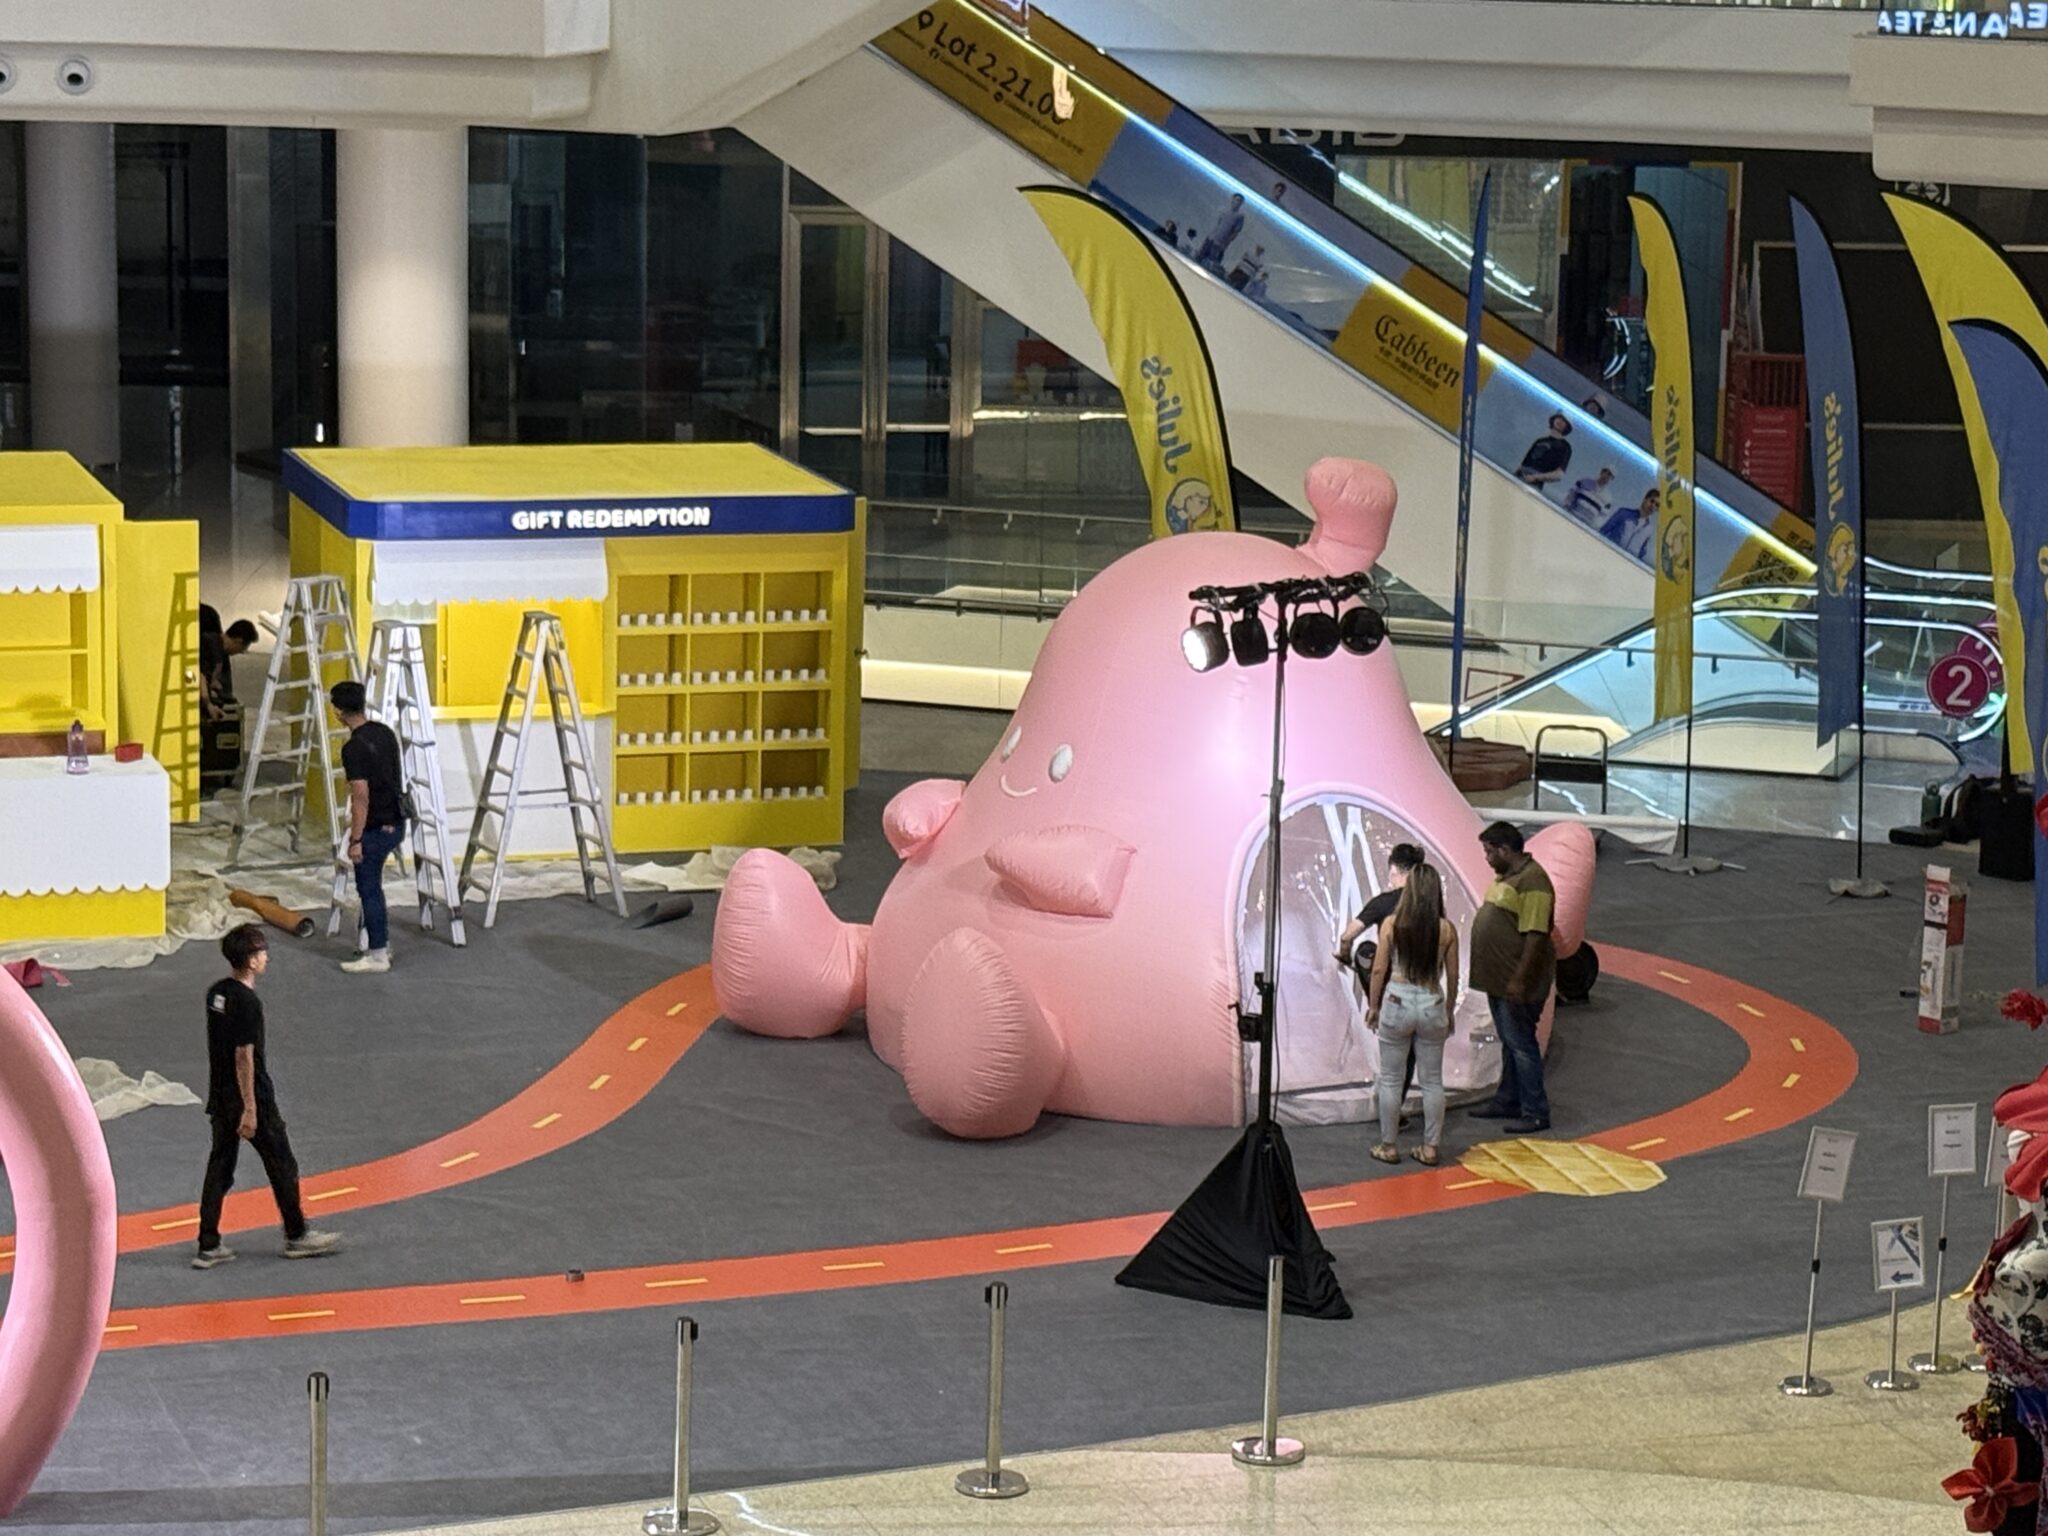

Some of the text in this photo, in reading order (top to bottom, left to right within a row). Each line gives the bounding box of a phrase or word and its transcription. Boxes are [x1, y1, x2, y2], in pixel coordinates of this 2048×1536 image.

[933, 21, 978, 66] Lot
[1375, 314, 1460, 388] Cabbeen
[511, 506, 712, 531] GIFT REDEMPTION
[1945, 664, 1973, 707] 2
